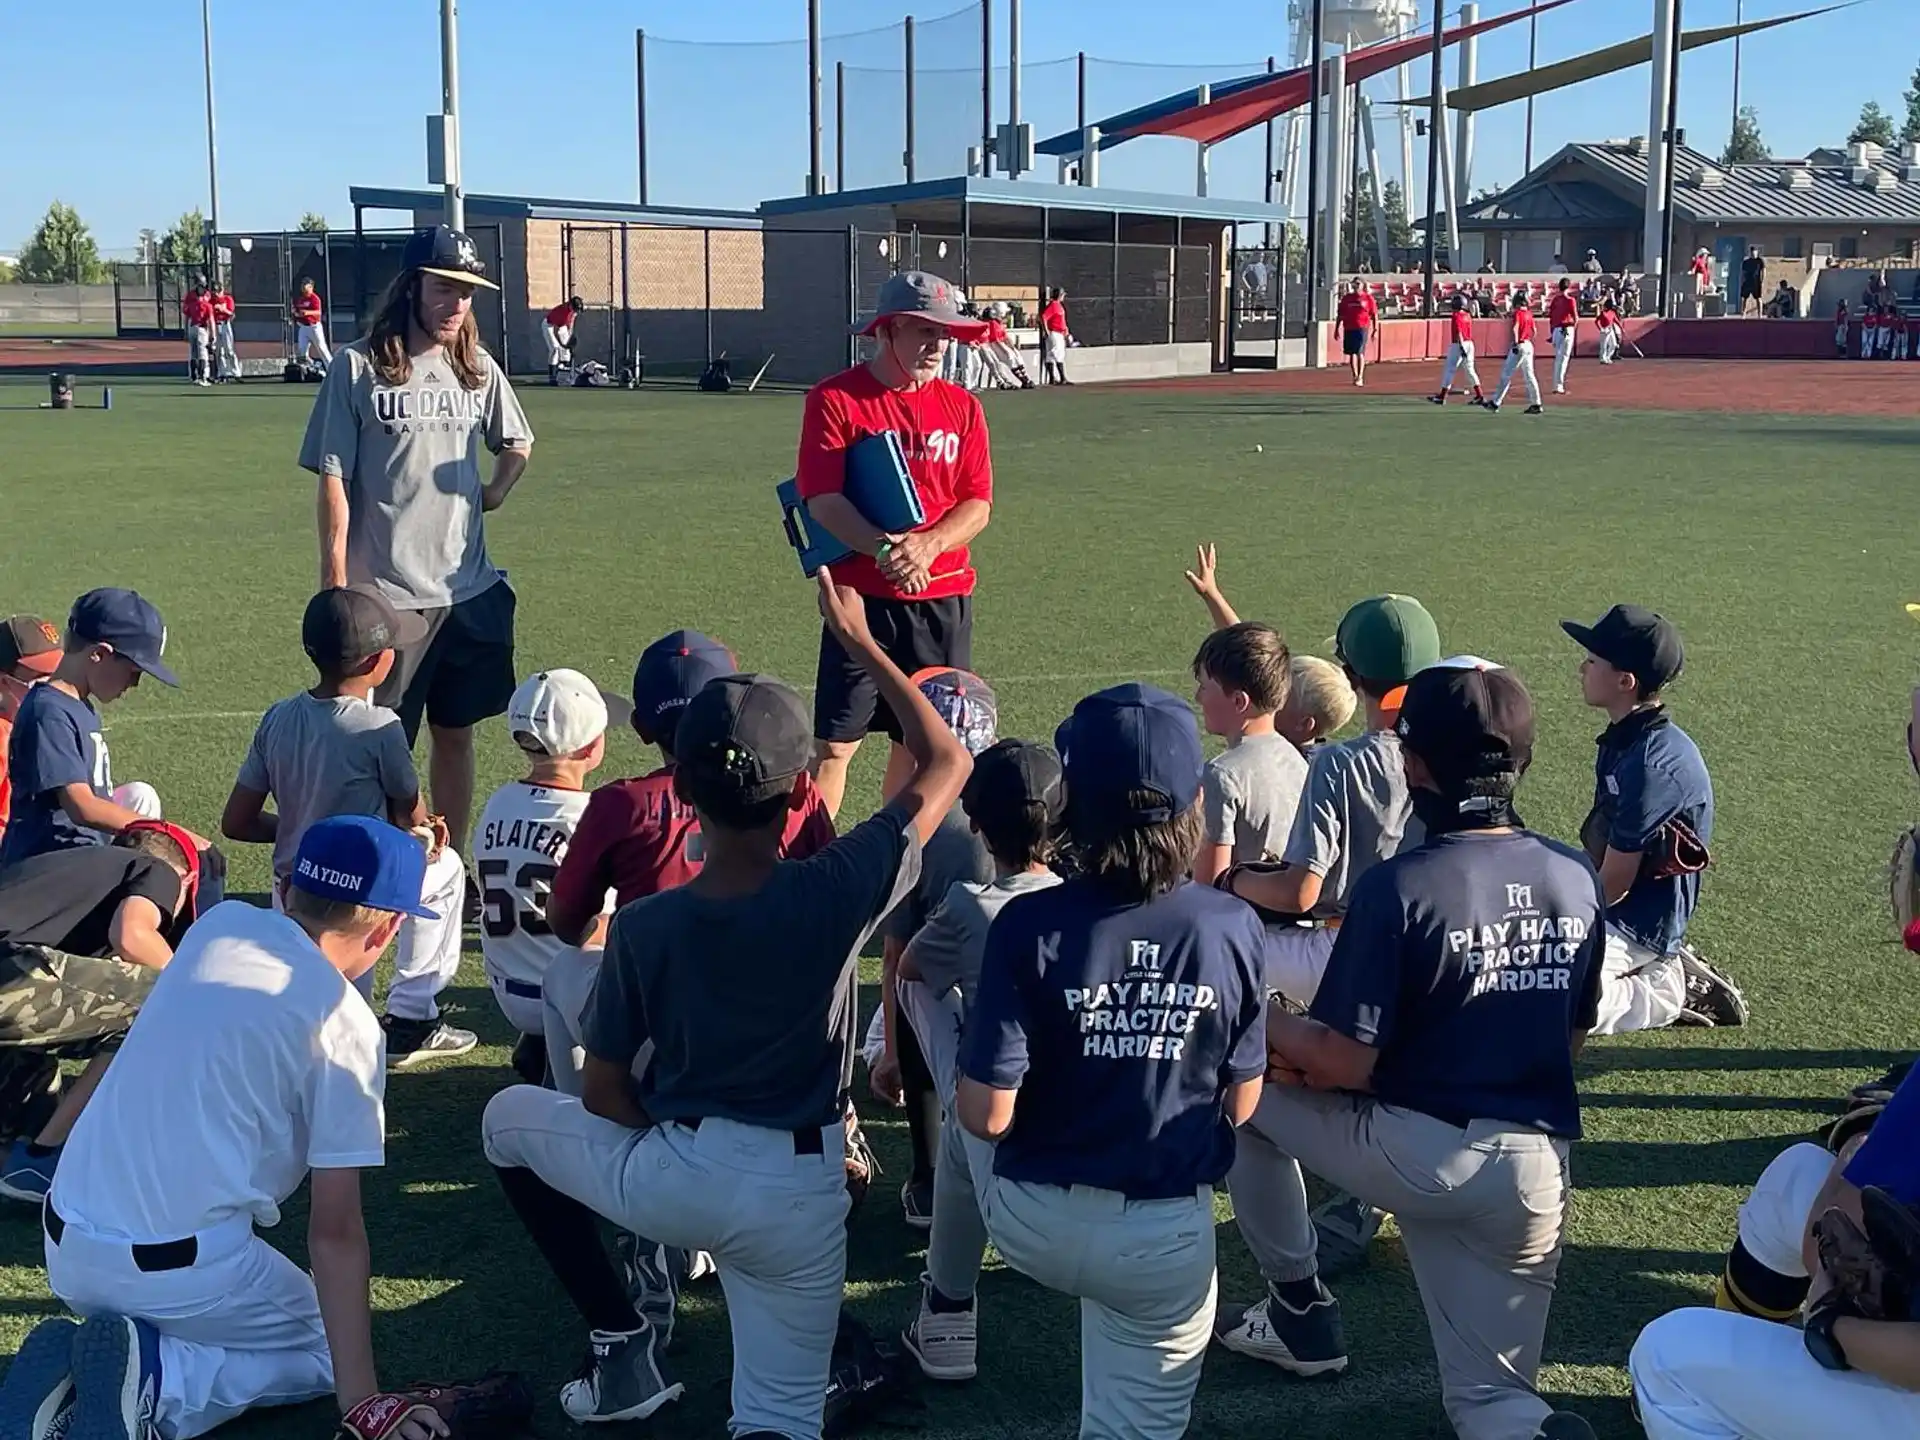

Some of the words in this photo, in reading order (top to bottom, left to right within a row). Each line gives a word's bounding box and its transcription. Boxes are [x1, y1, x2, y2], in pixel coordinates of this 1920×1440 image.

[374, 389, 412, 422] UC
[417, 387, 484, 420] DAVIS
[484, 818, 568, 859] SLATER
[1448, 921, 1512, 953] PLAY
[1520, 916, 1588, 942] HARD.
[1063, 982, 1134, 1011] PLAY
[1140, 982, 1219, 1010] HARD.
[1472, 968, 1571, 997] HARDER
[1083, 1034, 1185, 1061] HARDER
